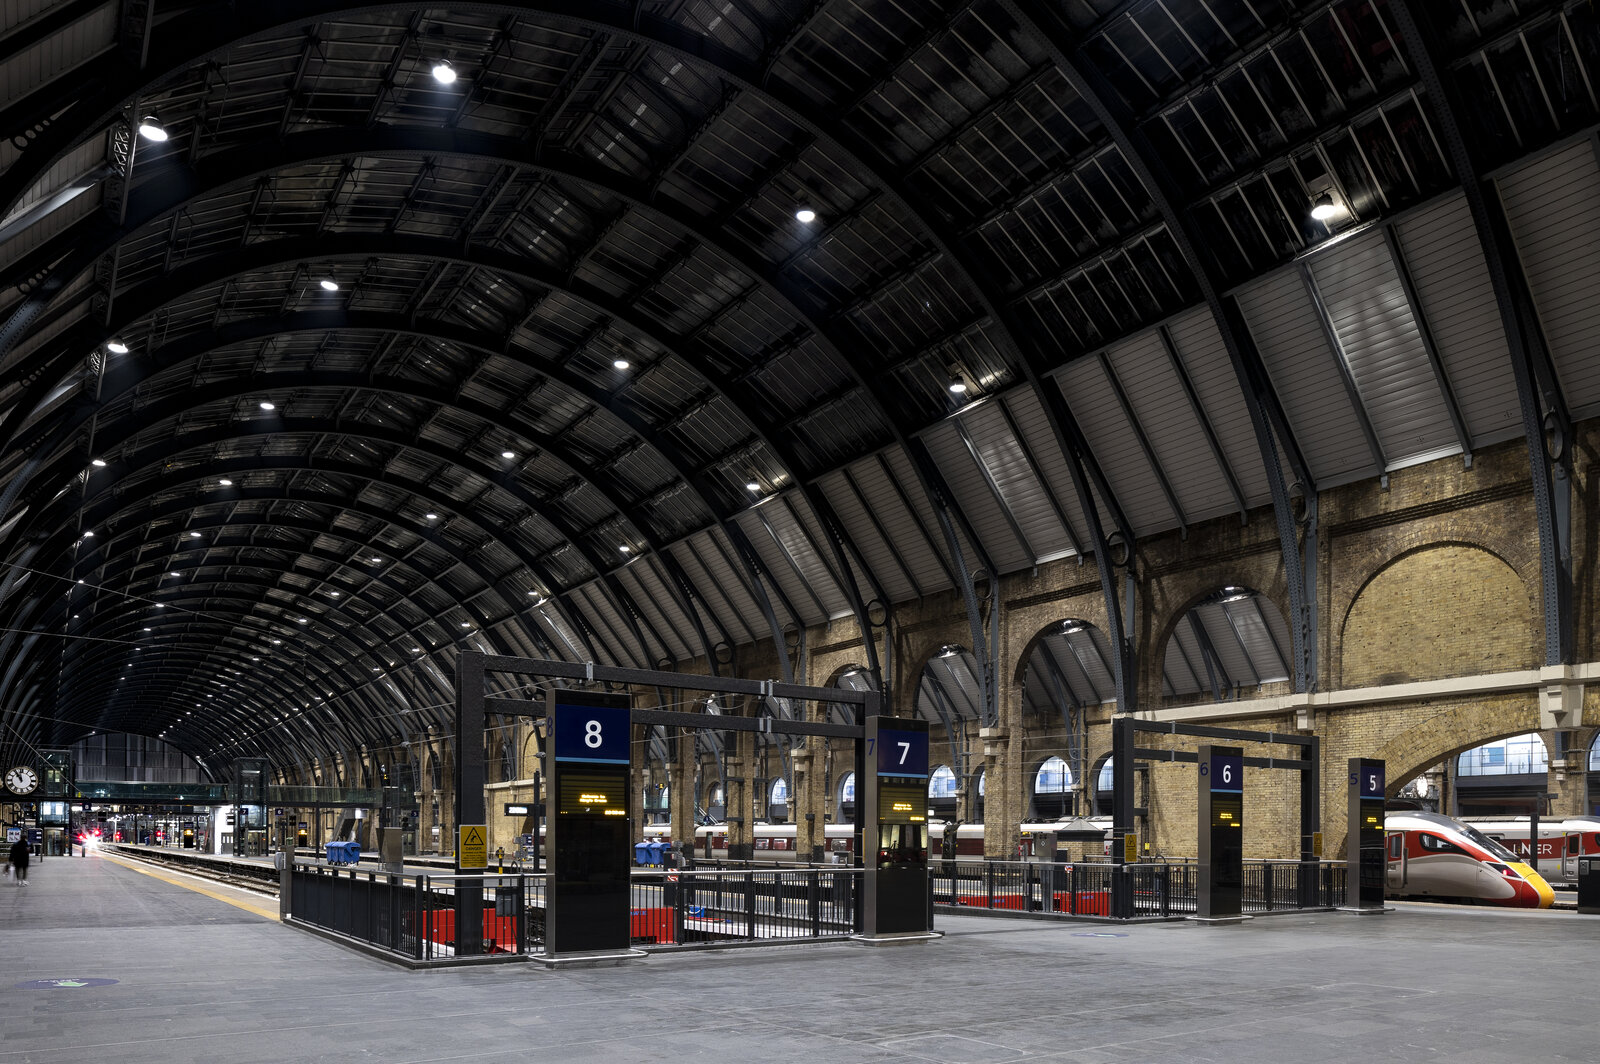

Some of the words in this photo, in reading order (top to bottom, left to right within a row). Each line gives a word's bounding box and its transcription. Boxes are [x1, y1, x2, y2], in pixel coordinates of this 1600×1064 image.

[547, 716, 553, 737] 8
[584, 719, 603, 749] 8
[867, 738, 876, 756] 7
[897, 741, 911, 765] 7
[1200, 762, 1209, 776] 6
[1222, 764, 1232, 784] 6
[1350, 772, 1359, 785] 5
[1369, 774, 1377, 792] 5
[1513, 842, 1553, 855] LNER
